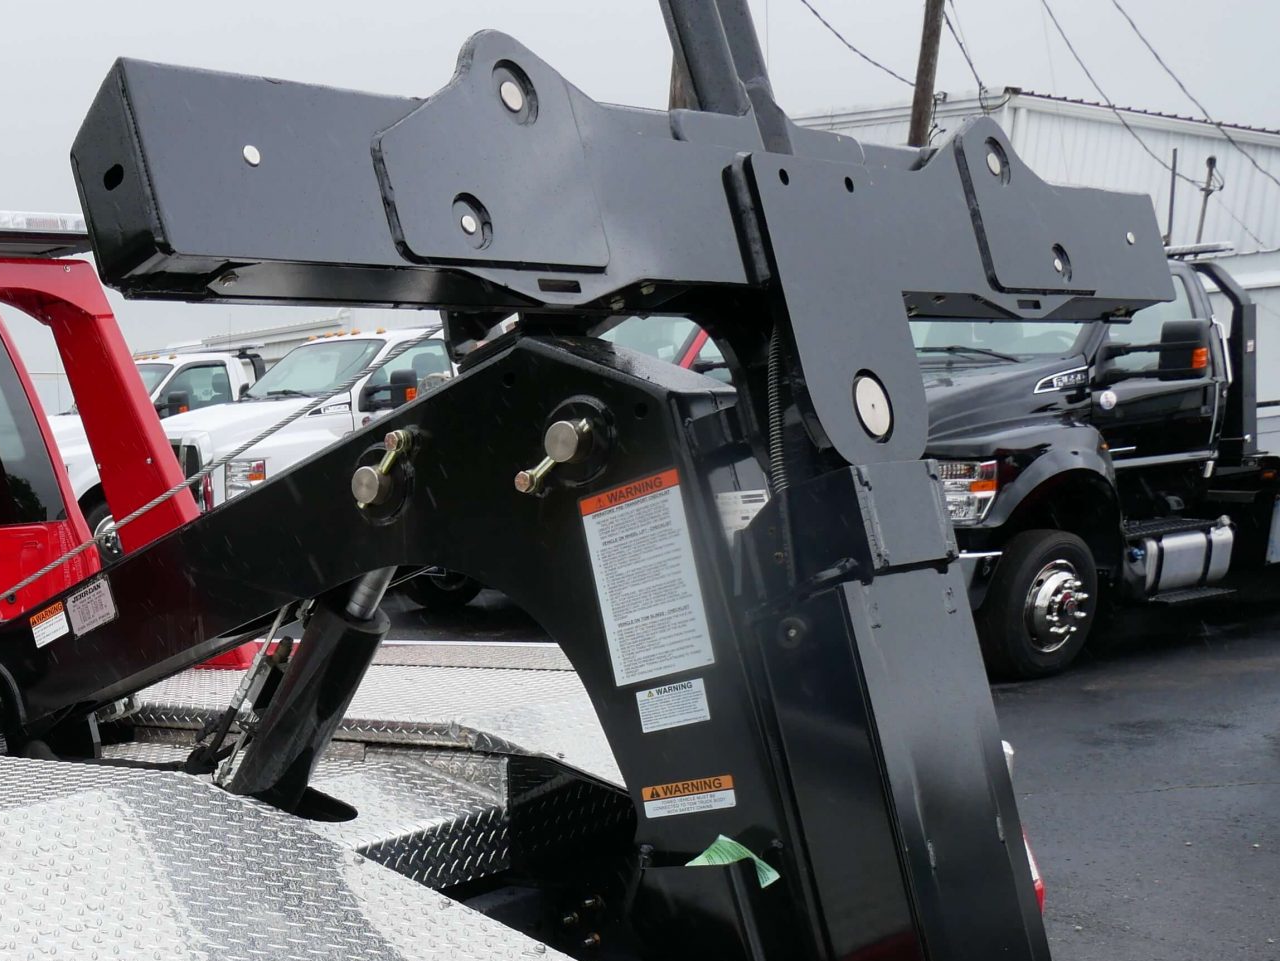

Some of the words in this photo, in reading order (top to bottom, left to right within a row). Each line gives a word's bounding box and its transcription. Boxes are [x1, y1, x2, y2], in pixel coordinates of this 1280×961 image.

[607, 477, 663, 503] WARNING
[36, 604, 62, 622] WARNING
[655, 681, 693, 695] WARNING
[662, 778, 722, 796] WARNING
